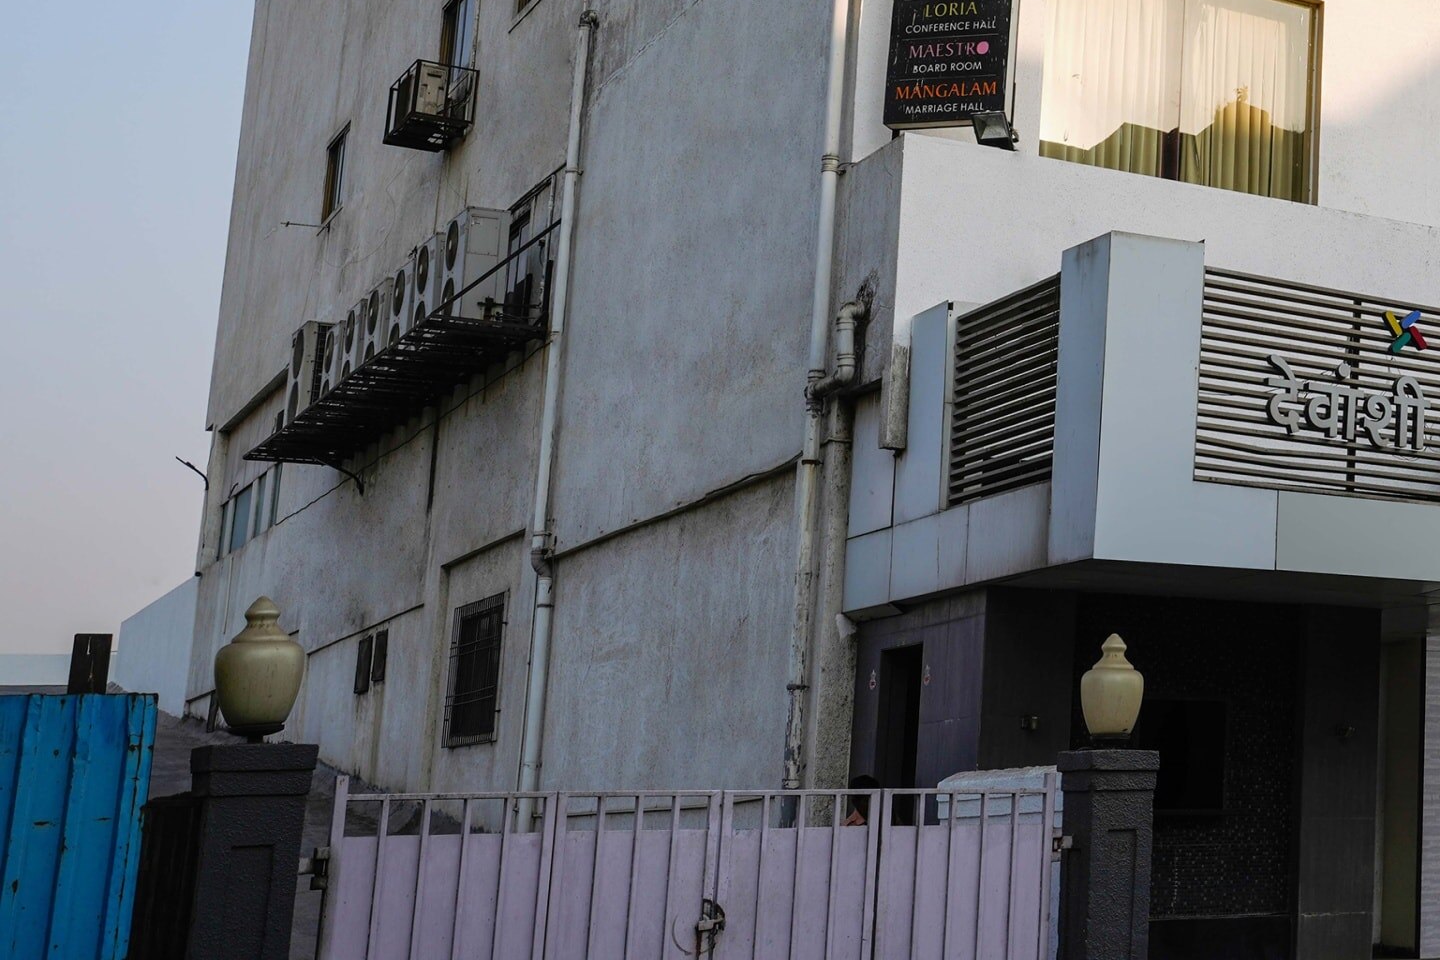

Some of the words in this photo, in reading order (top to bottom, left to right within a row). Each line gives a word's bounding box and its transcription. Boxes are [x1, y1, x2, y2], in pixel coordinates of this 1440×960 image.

[924, 1, 978, 18] LORIA
[905, 21, 970, 34] CONFERENCE
[972, 19, 997, 30] HALL
[909, 41, 989, 58] MAESTRO
[912, 63, 947, 73] BOARD
[950, 61, 982, 71] ROOM
[895, 80, 997, 100] MANGALAM
[905, 103, 958, 115] MARRIAGE
[960, 101, 984, 112] HALL
[1264, 354, 1430, 451] देवांशी
